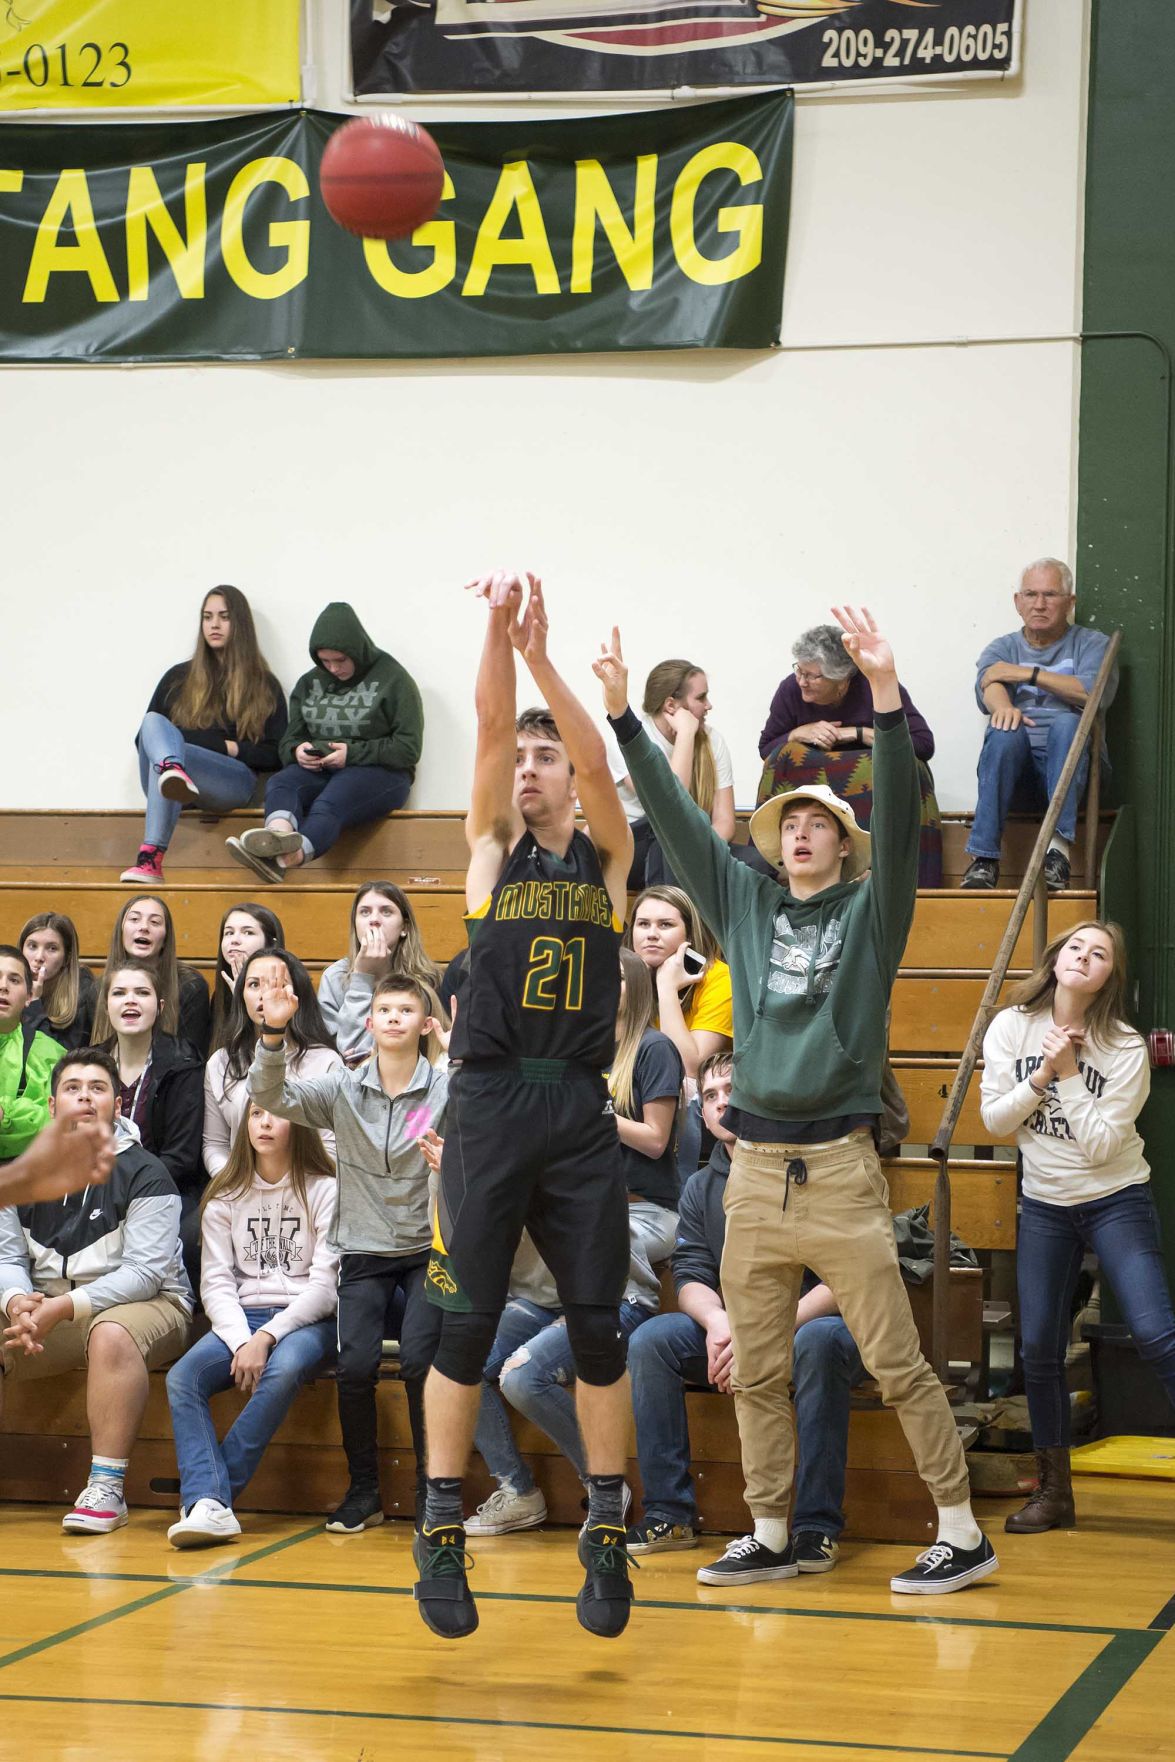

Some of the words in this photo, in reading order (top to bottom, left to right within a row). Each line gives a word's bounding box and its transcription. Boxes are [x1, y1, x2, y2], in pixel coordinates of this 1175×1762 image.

[0, 42, 132, 88] -0123
[821, 22, 1010, 67] 209-274-0605
[522, 936, 585, 1010] 21
